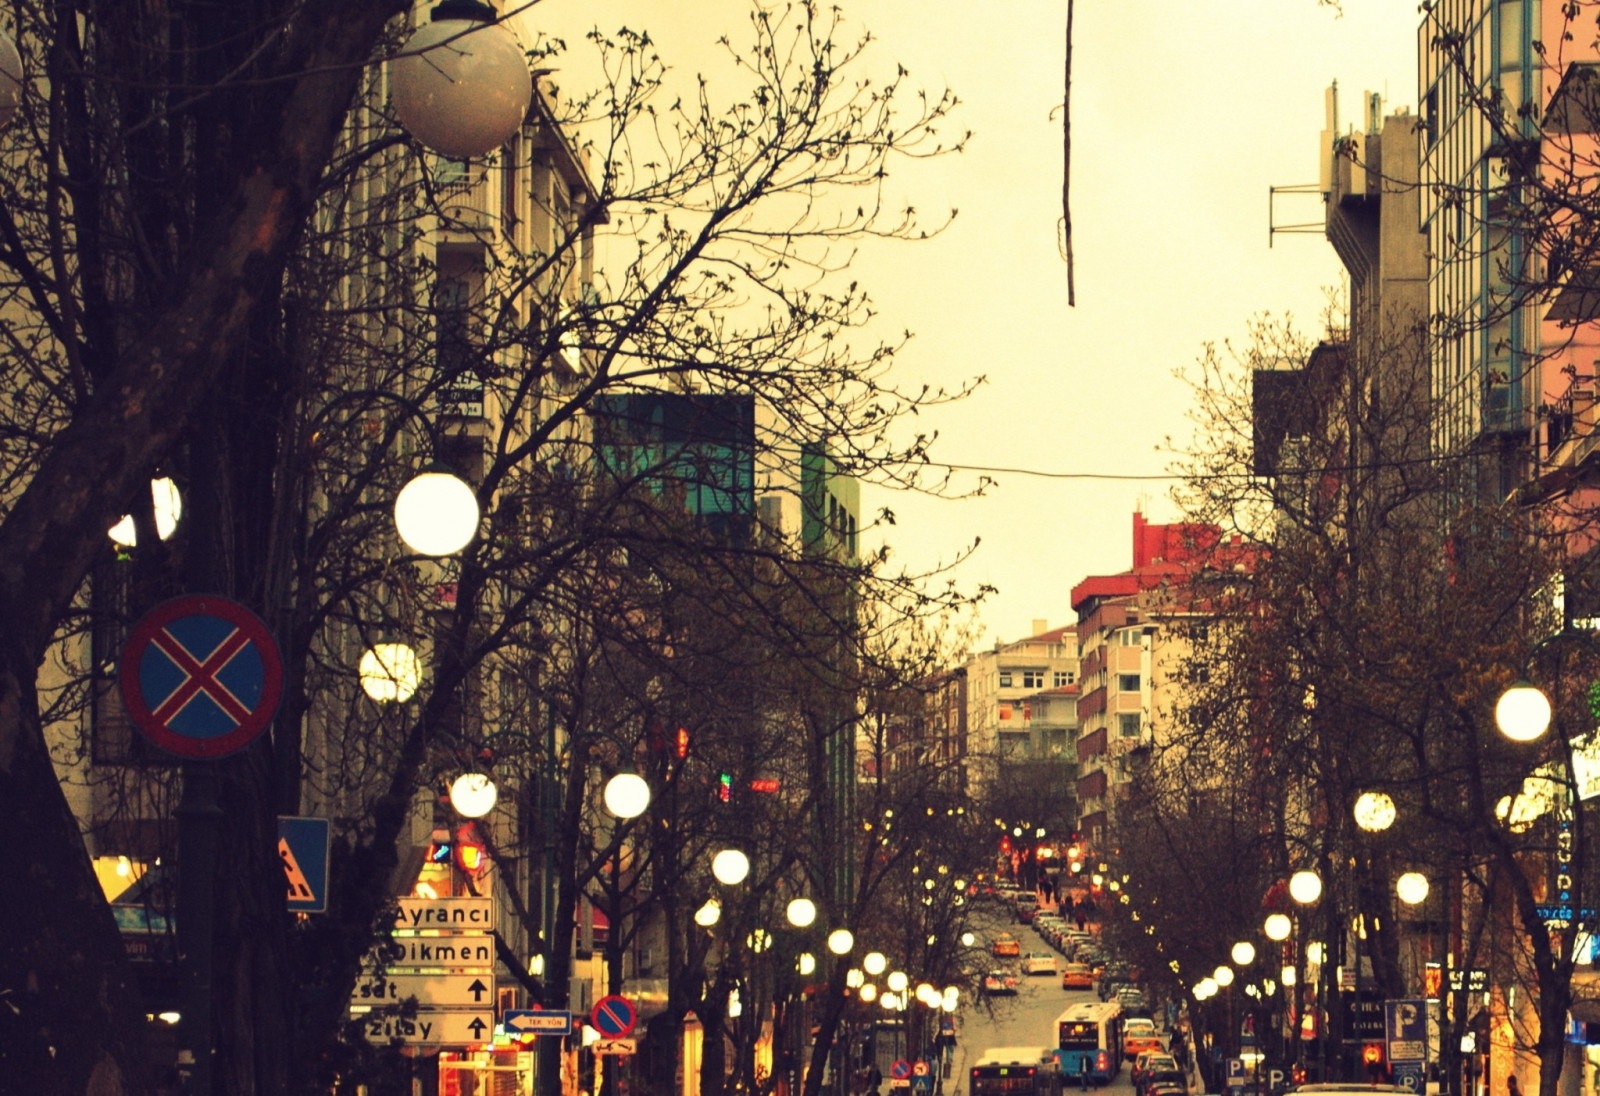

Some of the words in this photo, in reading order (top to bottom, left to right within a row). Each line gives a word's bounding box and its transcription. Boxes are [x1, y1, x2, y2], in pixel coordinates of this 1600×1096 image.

[396, 906, 489, 926] Ayrancı
[352, 981, 397, 998] sat
[528, 1018, 542, 1026] TEK
[547, 1017, 562, 1026] YÖN
[1395, 1004, 1418, 1037] P
[1230, 1060, 1241, 1076] P
[1270, 1069, 1284, 1090] P
